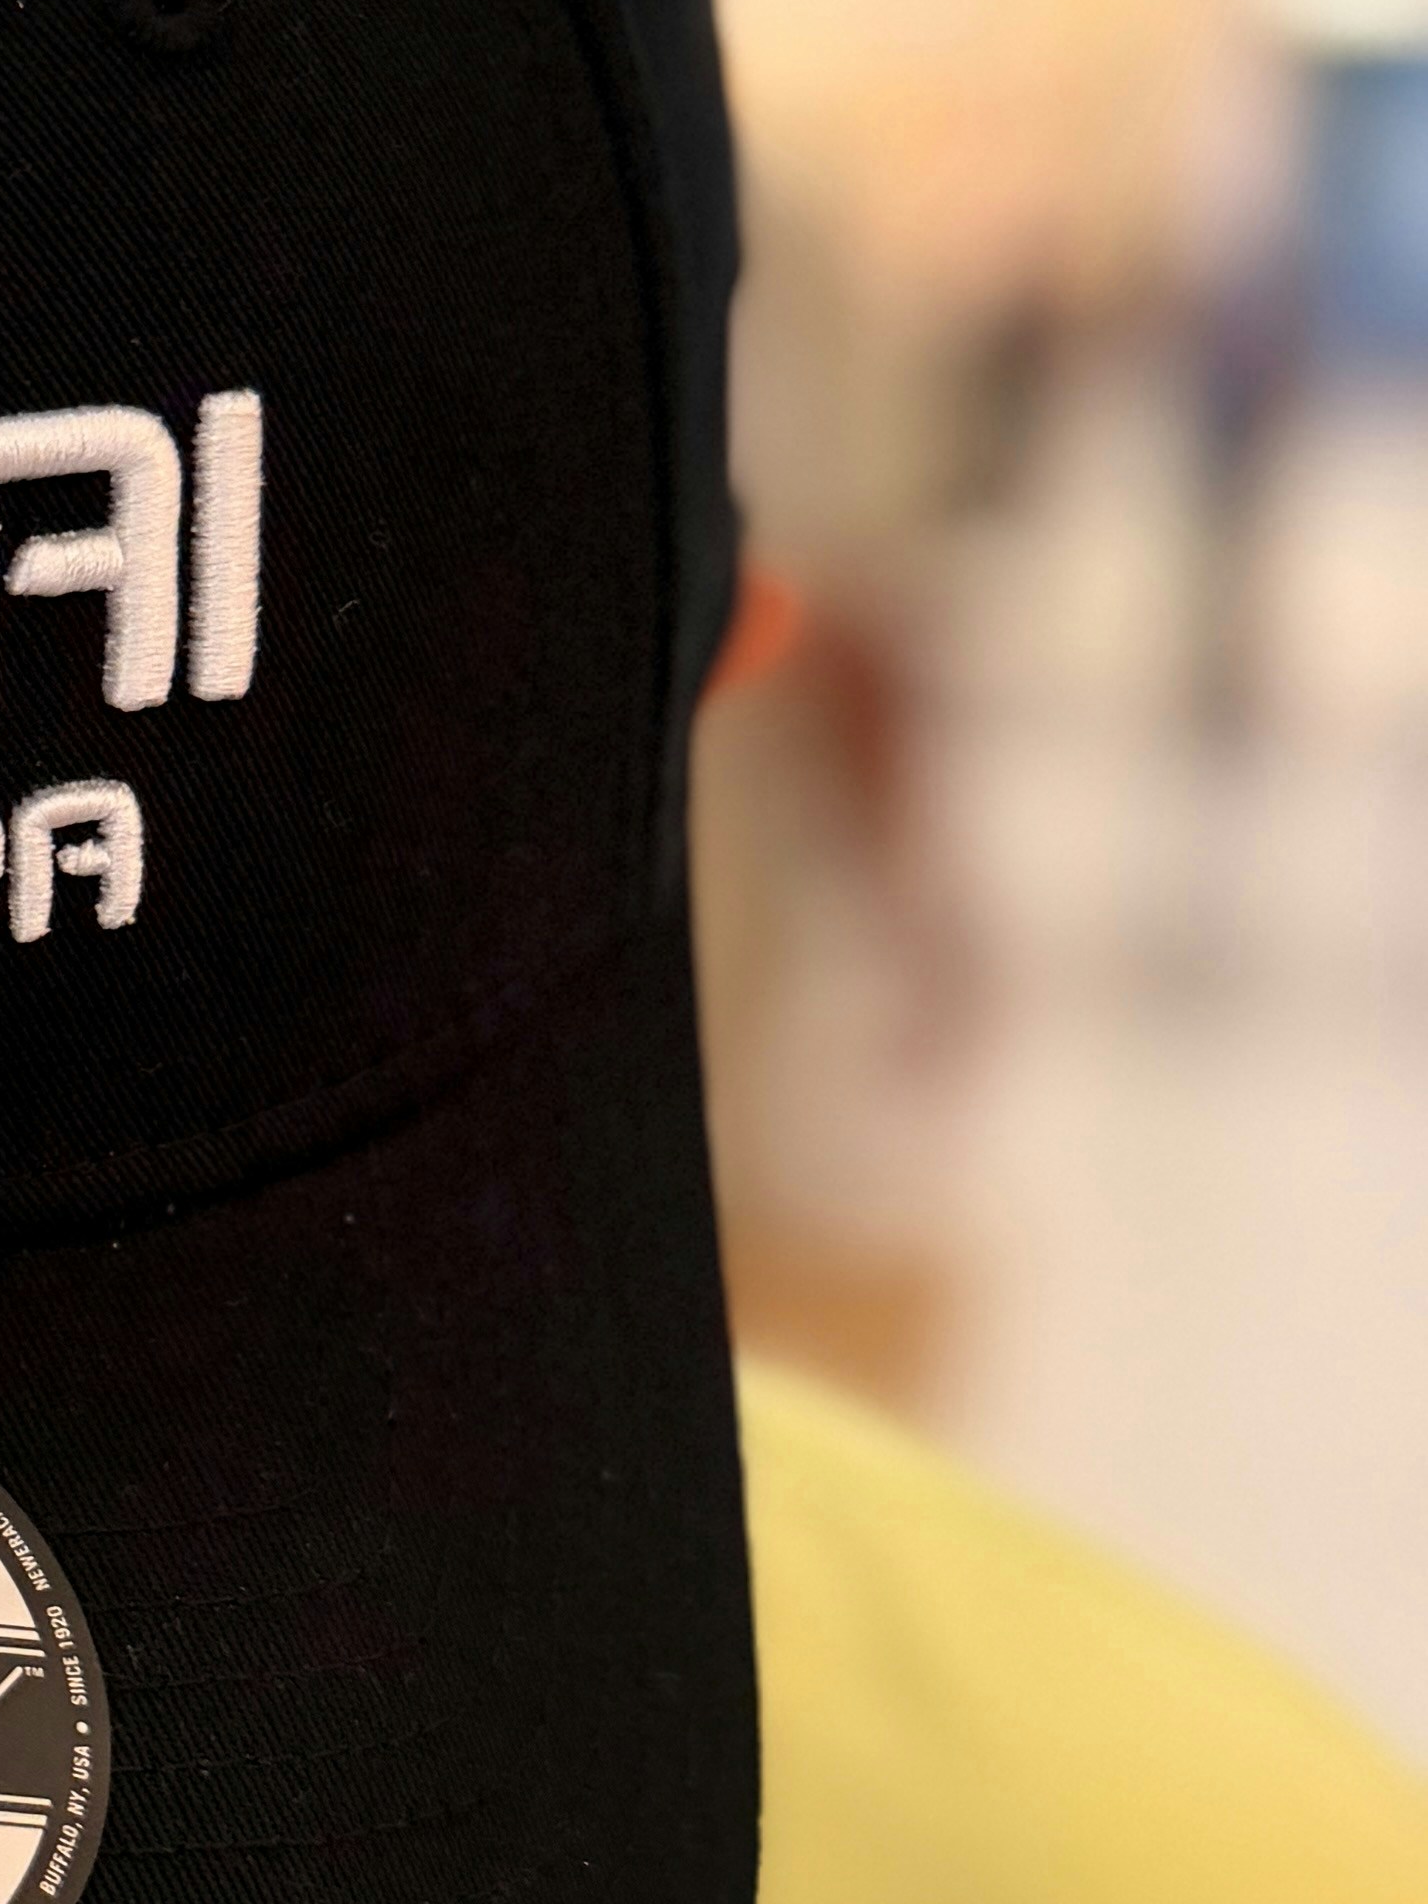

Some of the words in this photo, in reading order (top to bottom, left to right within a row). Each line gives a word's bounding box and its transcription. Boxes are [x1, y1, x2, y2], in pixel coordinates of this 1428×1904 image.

[46, 1605, 75, 1649] 1920
[63, 1655, 88, 1706] SINCE
[39, 1823, 84, 1896] BUFFALO,
[72, 1745, 91, 1780] USA
